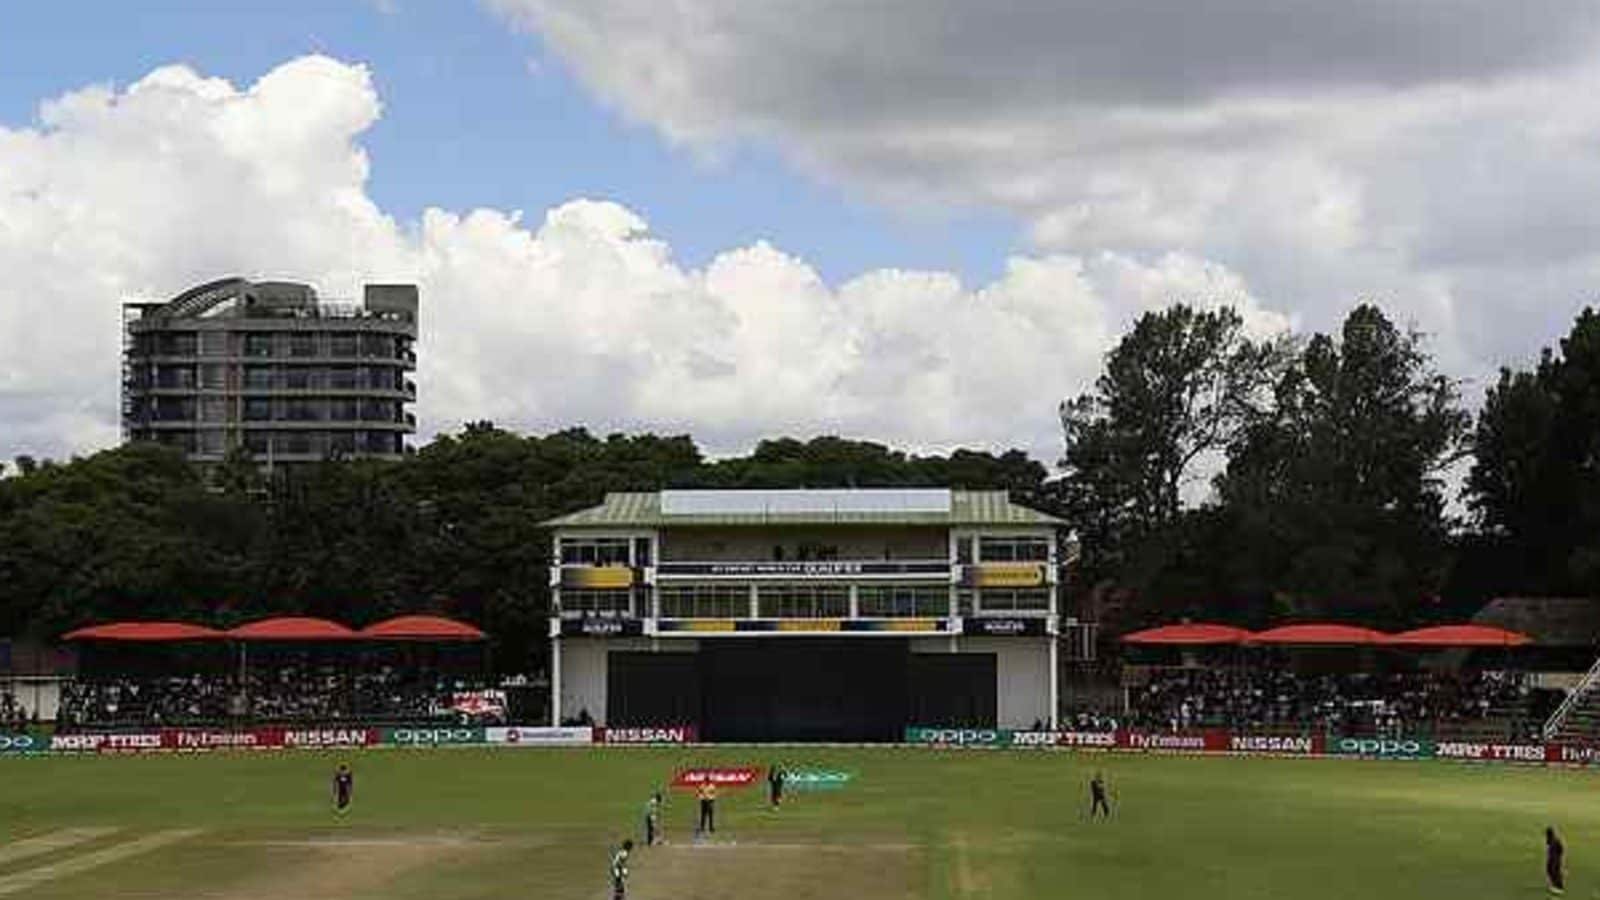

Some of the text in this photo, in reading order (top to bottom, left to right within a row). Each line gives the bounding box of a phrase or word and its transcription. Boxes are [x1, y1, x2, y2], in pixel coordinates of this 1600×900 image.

[284, 730, 367, 744] NISSAN
[605, 728, 685, 742] NISSAN
[1231, 736, 1313, 752] NISSAN
